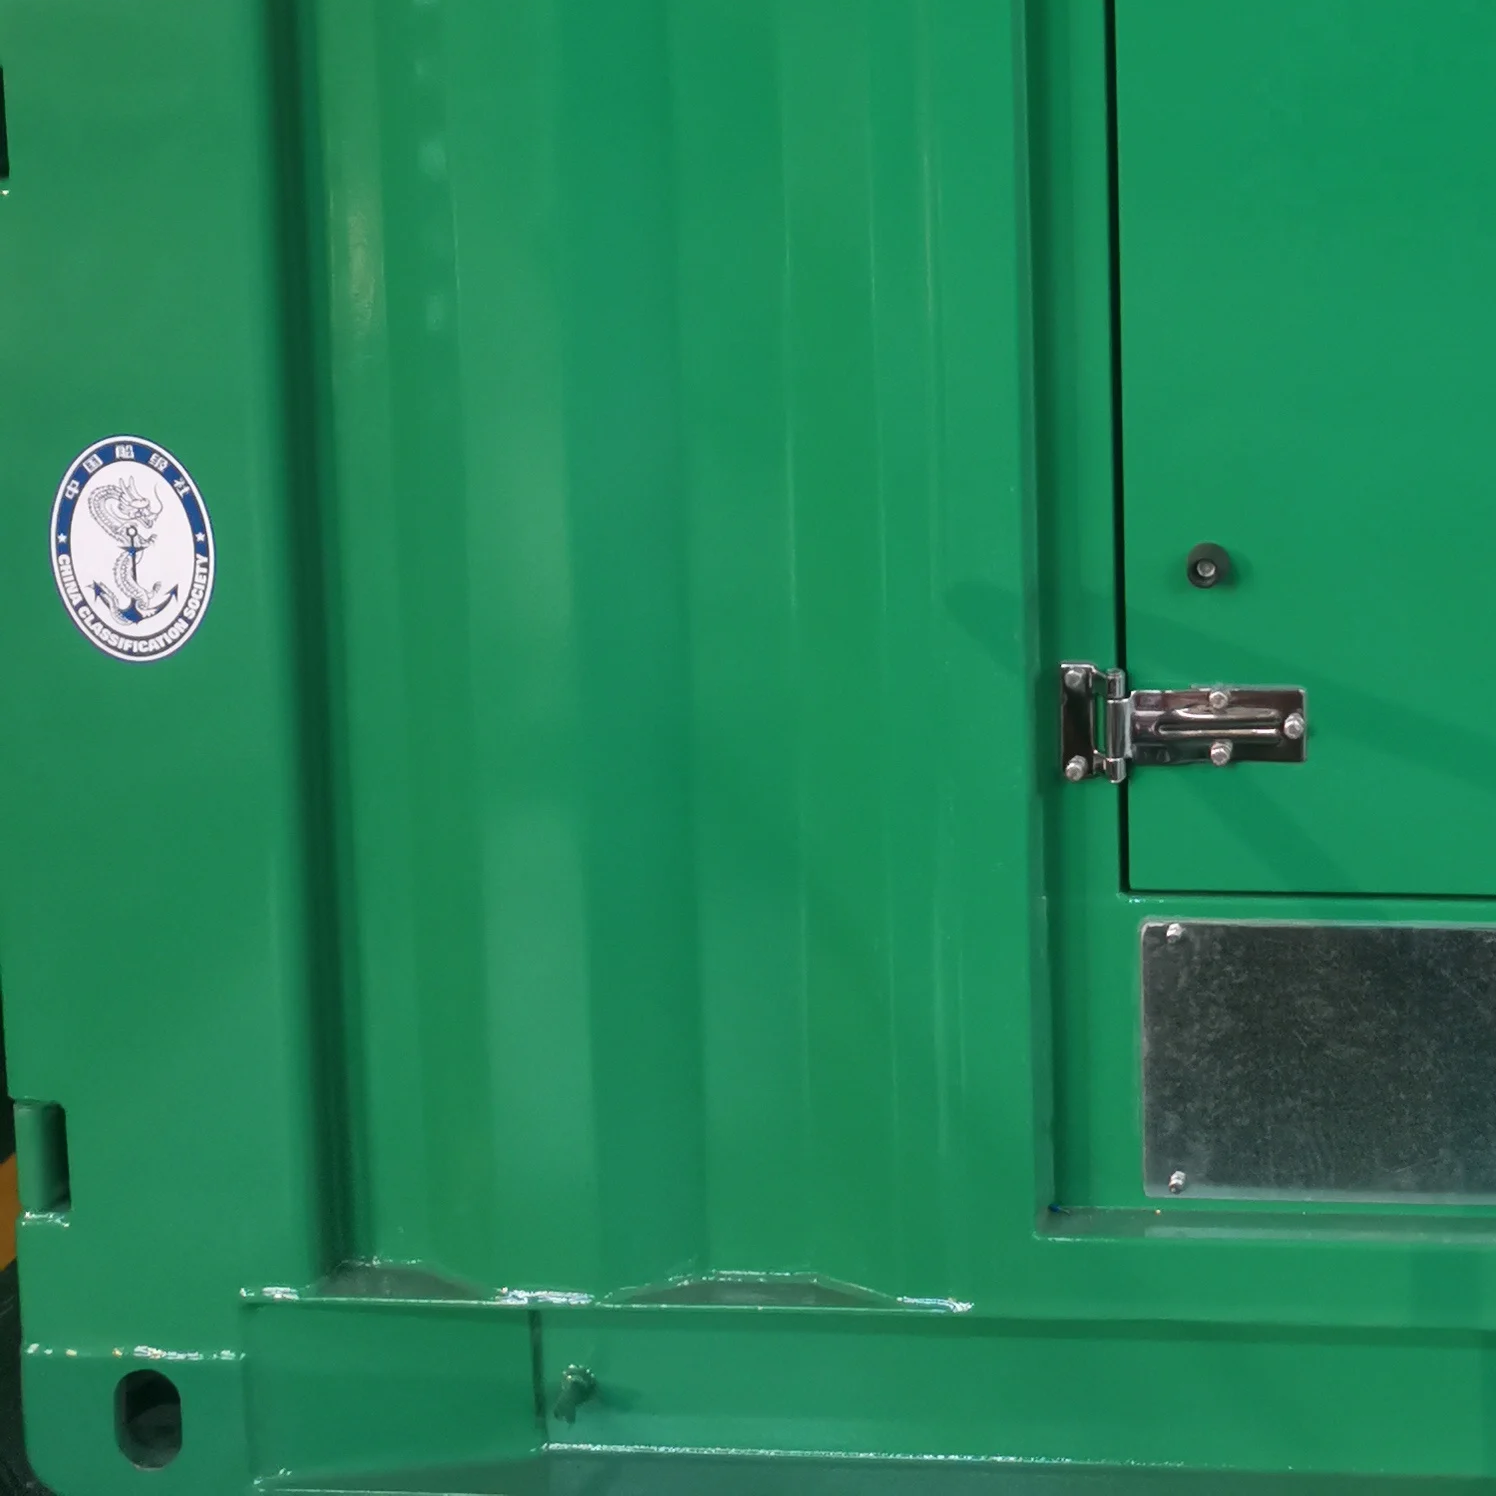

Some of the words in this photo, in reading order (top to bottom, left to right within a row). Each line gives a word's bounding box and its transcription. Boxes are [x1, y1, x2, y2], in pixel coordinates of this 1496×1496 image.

[57, 553, 83, 606] CHINA
[77, 602, 190, 654] CLASSIFICATION
[183, 553, 209, 621] SOCIETY
